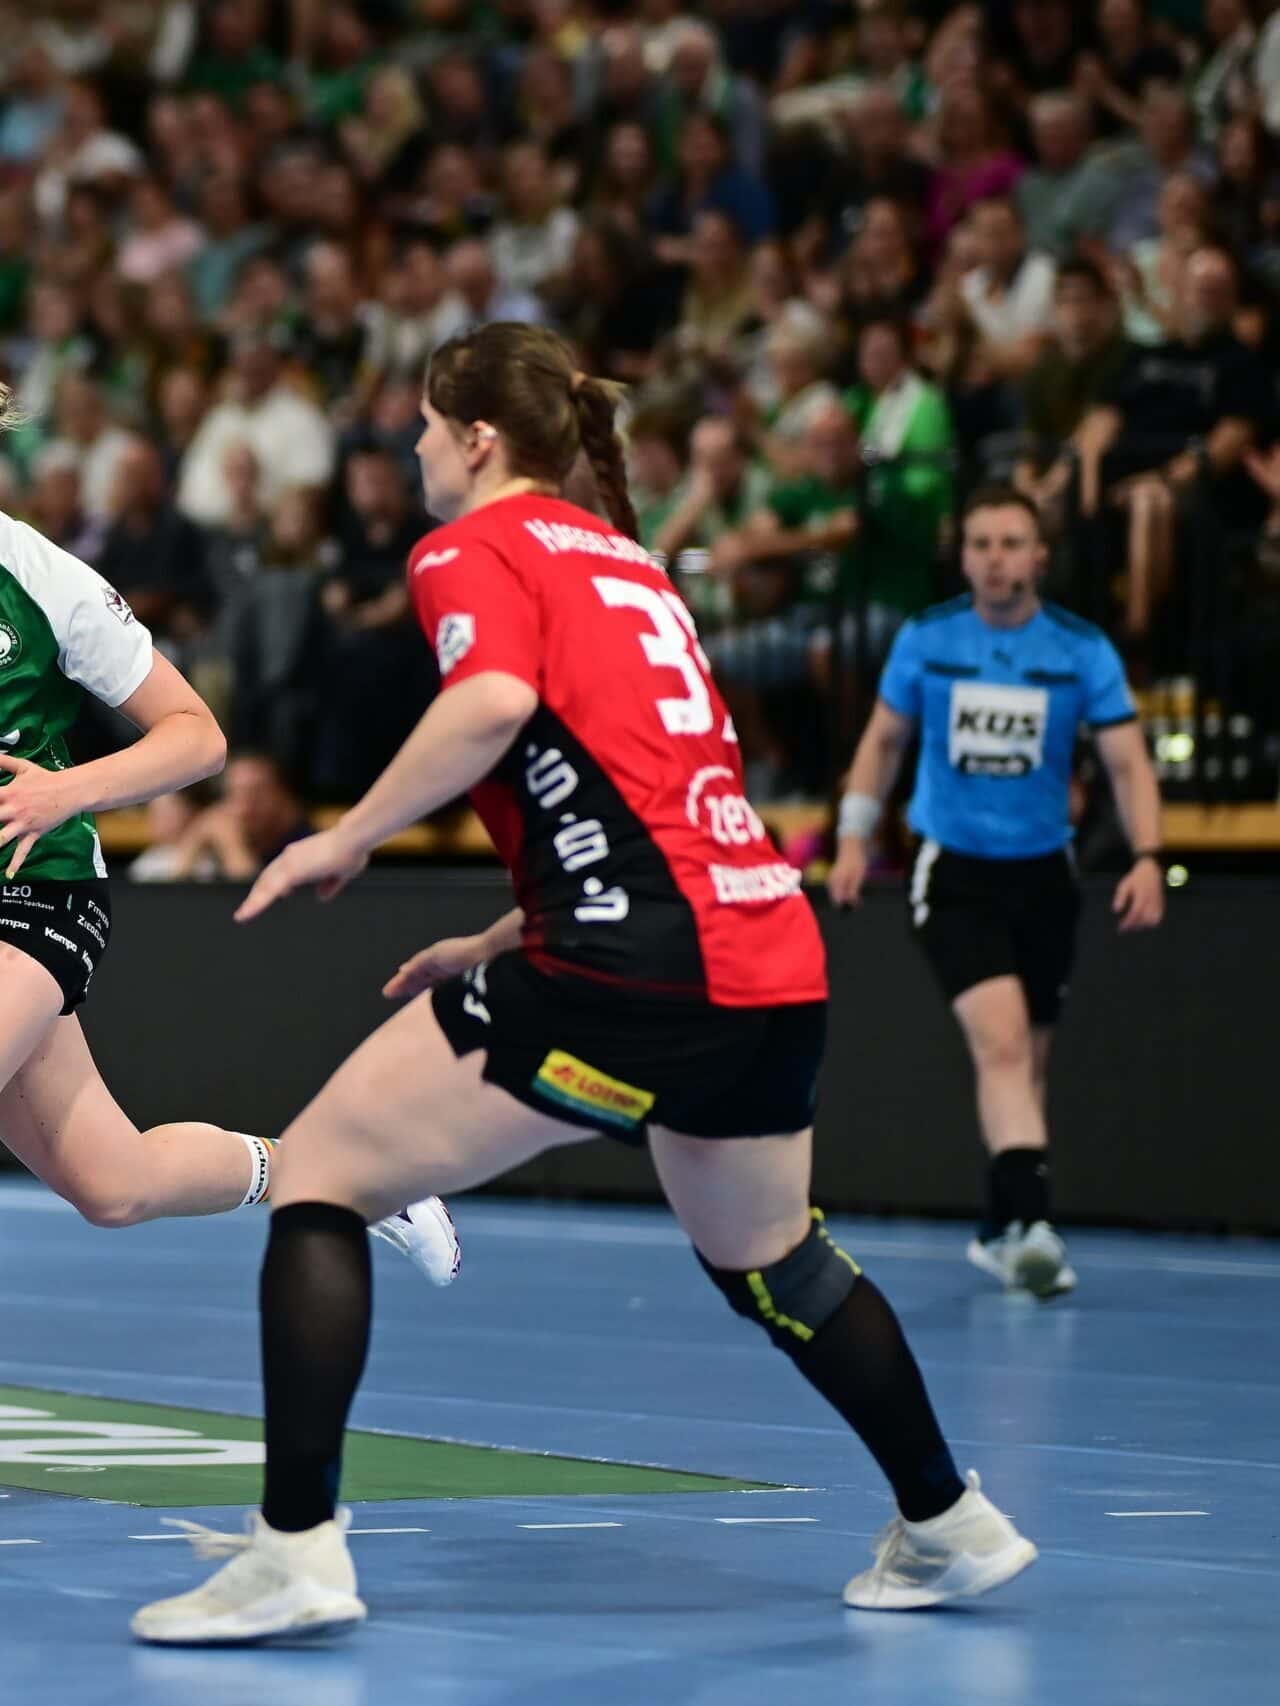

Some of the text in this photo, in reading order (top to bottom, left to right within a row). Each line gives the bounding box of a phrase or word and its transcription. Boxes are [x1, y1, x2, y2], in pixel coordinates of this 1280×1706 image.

[591, 575, 738, 743] 3
[23, 900, 55, 911] Sparkasse
[44, 926, 78, 952] Kempa
